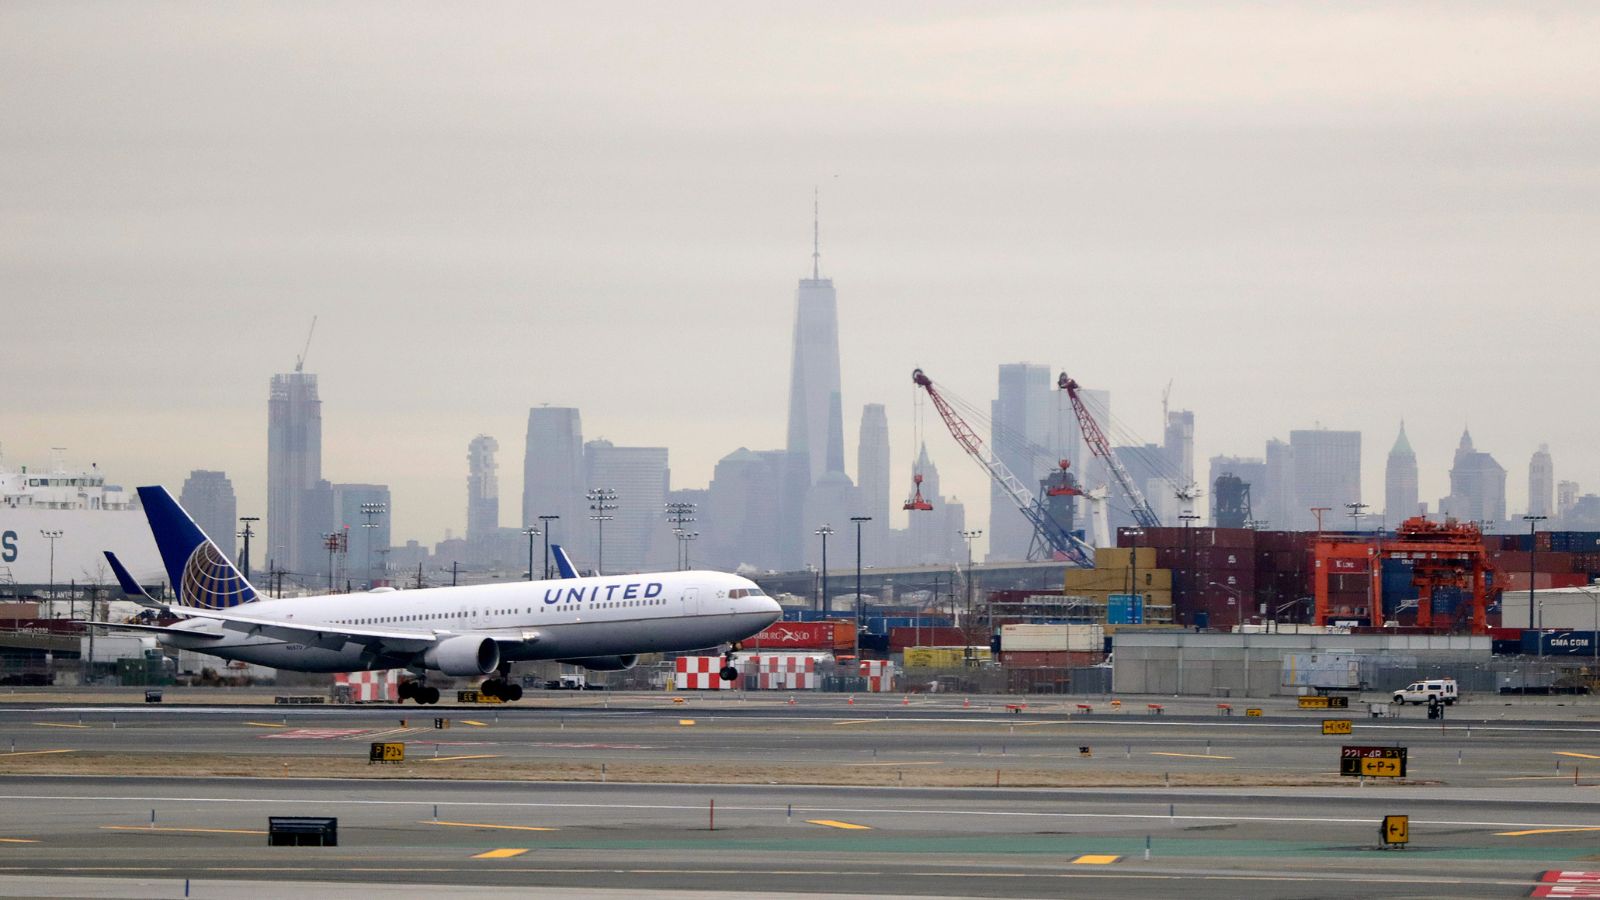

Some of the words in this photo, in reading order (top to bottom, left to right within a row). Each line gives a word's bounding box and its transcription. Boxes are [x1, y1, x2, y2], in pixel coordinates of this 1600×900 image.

[544, 582, 663, 605] UNITED
[1550, 638, 1568, 646] CMA
[1570, 638, 1589, 646] CGM
[1348, 760, 1356, 772] J
[1377, 761, 1385, 772] P
[1399, 821, 1406, 837] J
